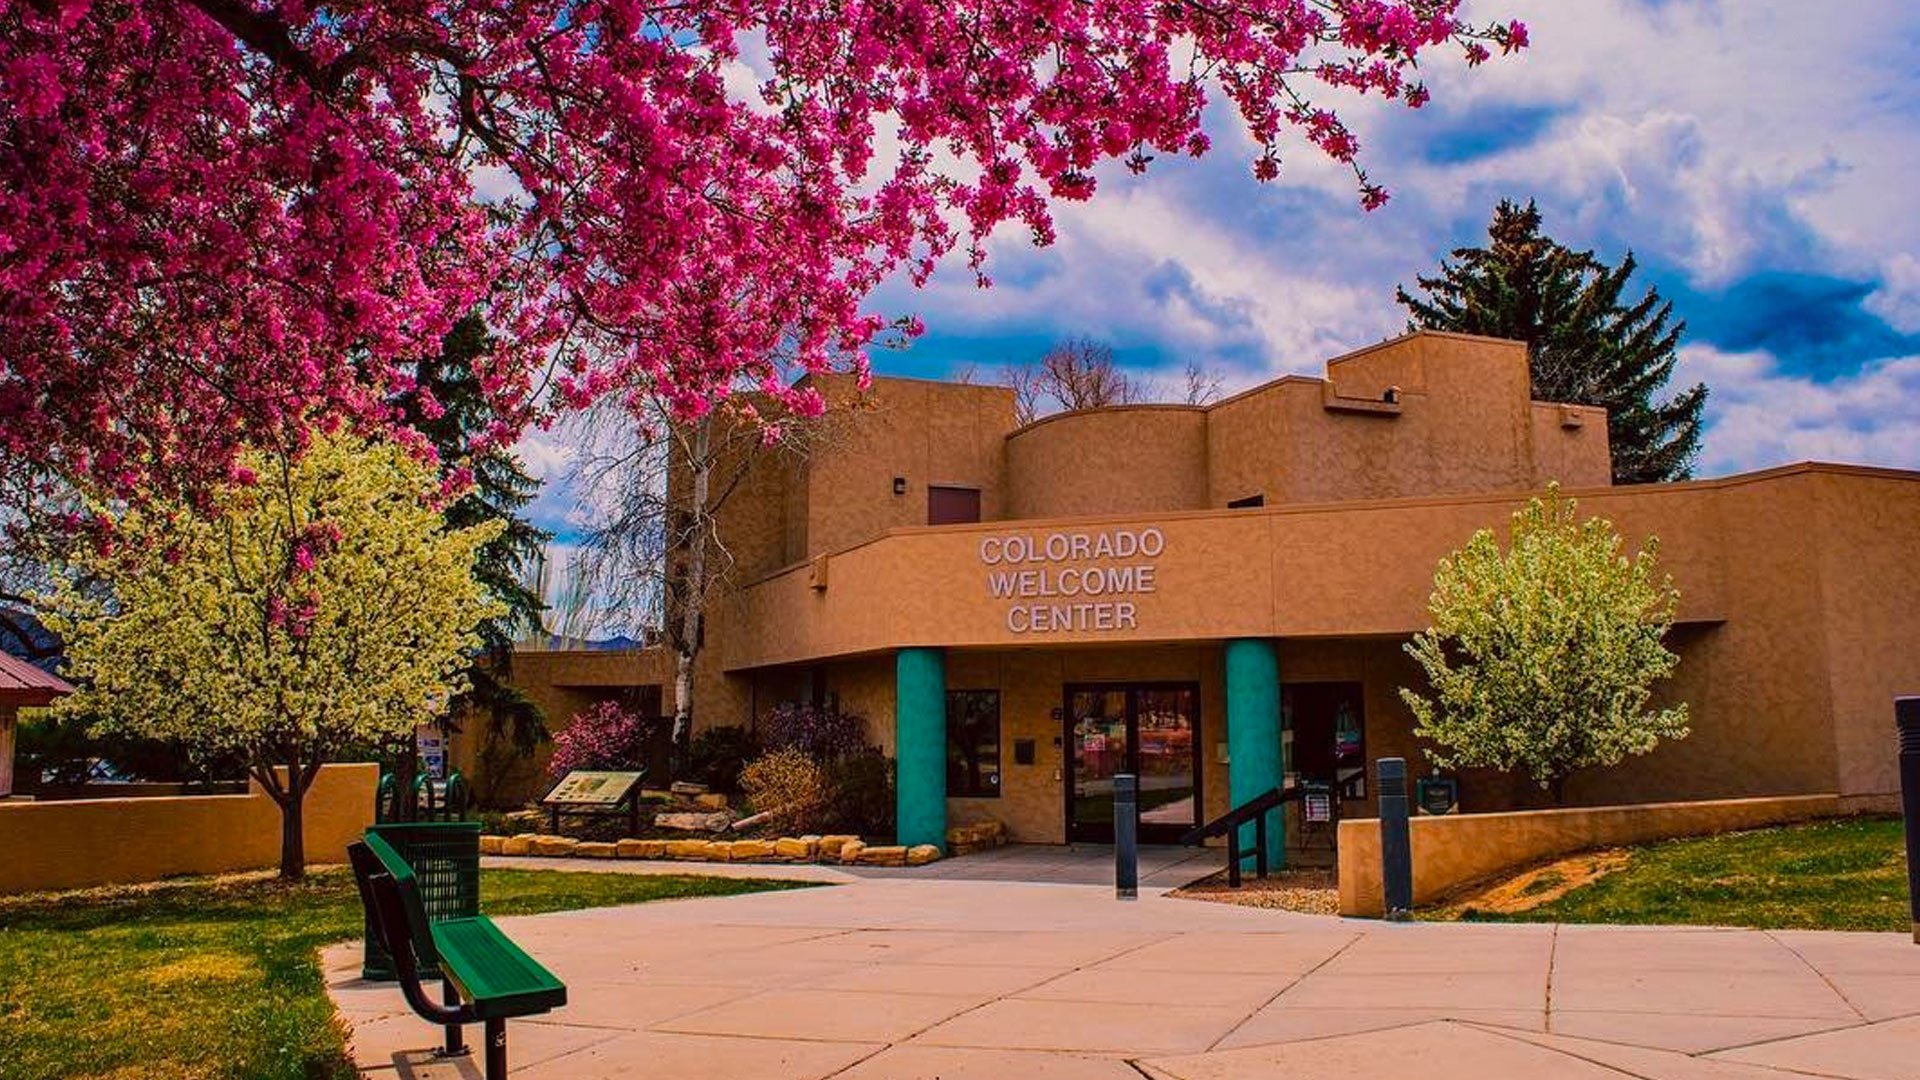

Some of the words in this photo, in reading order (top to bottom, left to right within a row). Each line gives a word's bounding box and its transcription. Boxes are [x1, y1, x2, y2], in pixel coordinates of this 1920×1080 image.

[981, 528, 1164, 564] COLORADO
[988, 566, 1156, 598] WELCOME
[1008, 603, 1137, 633] CENTER
